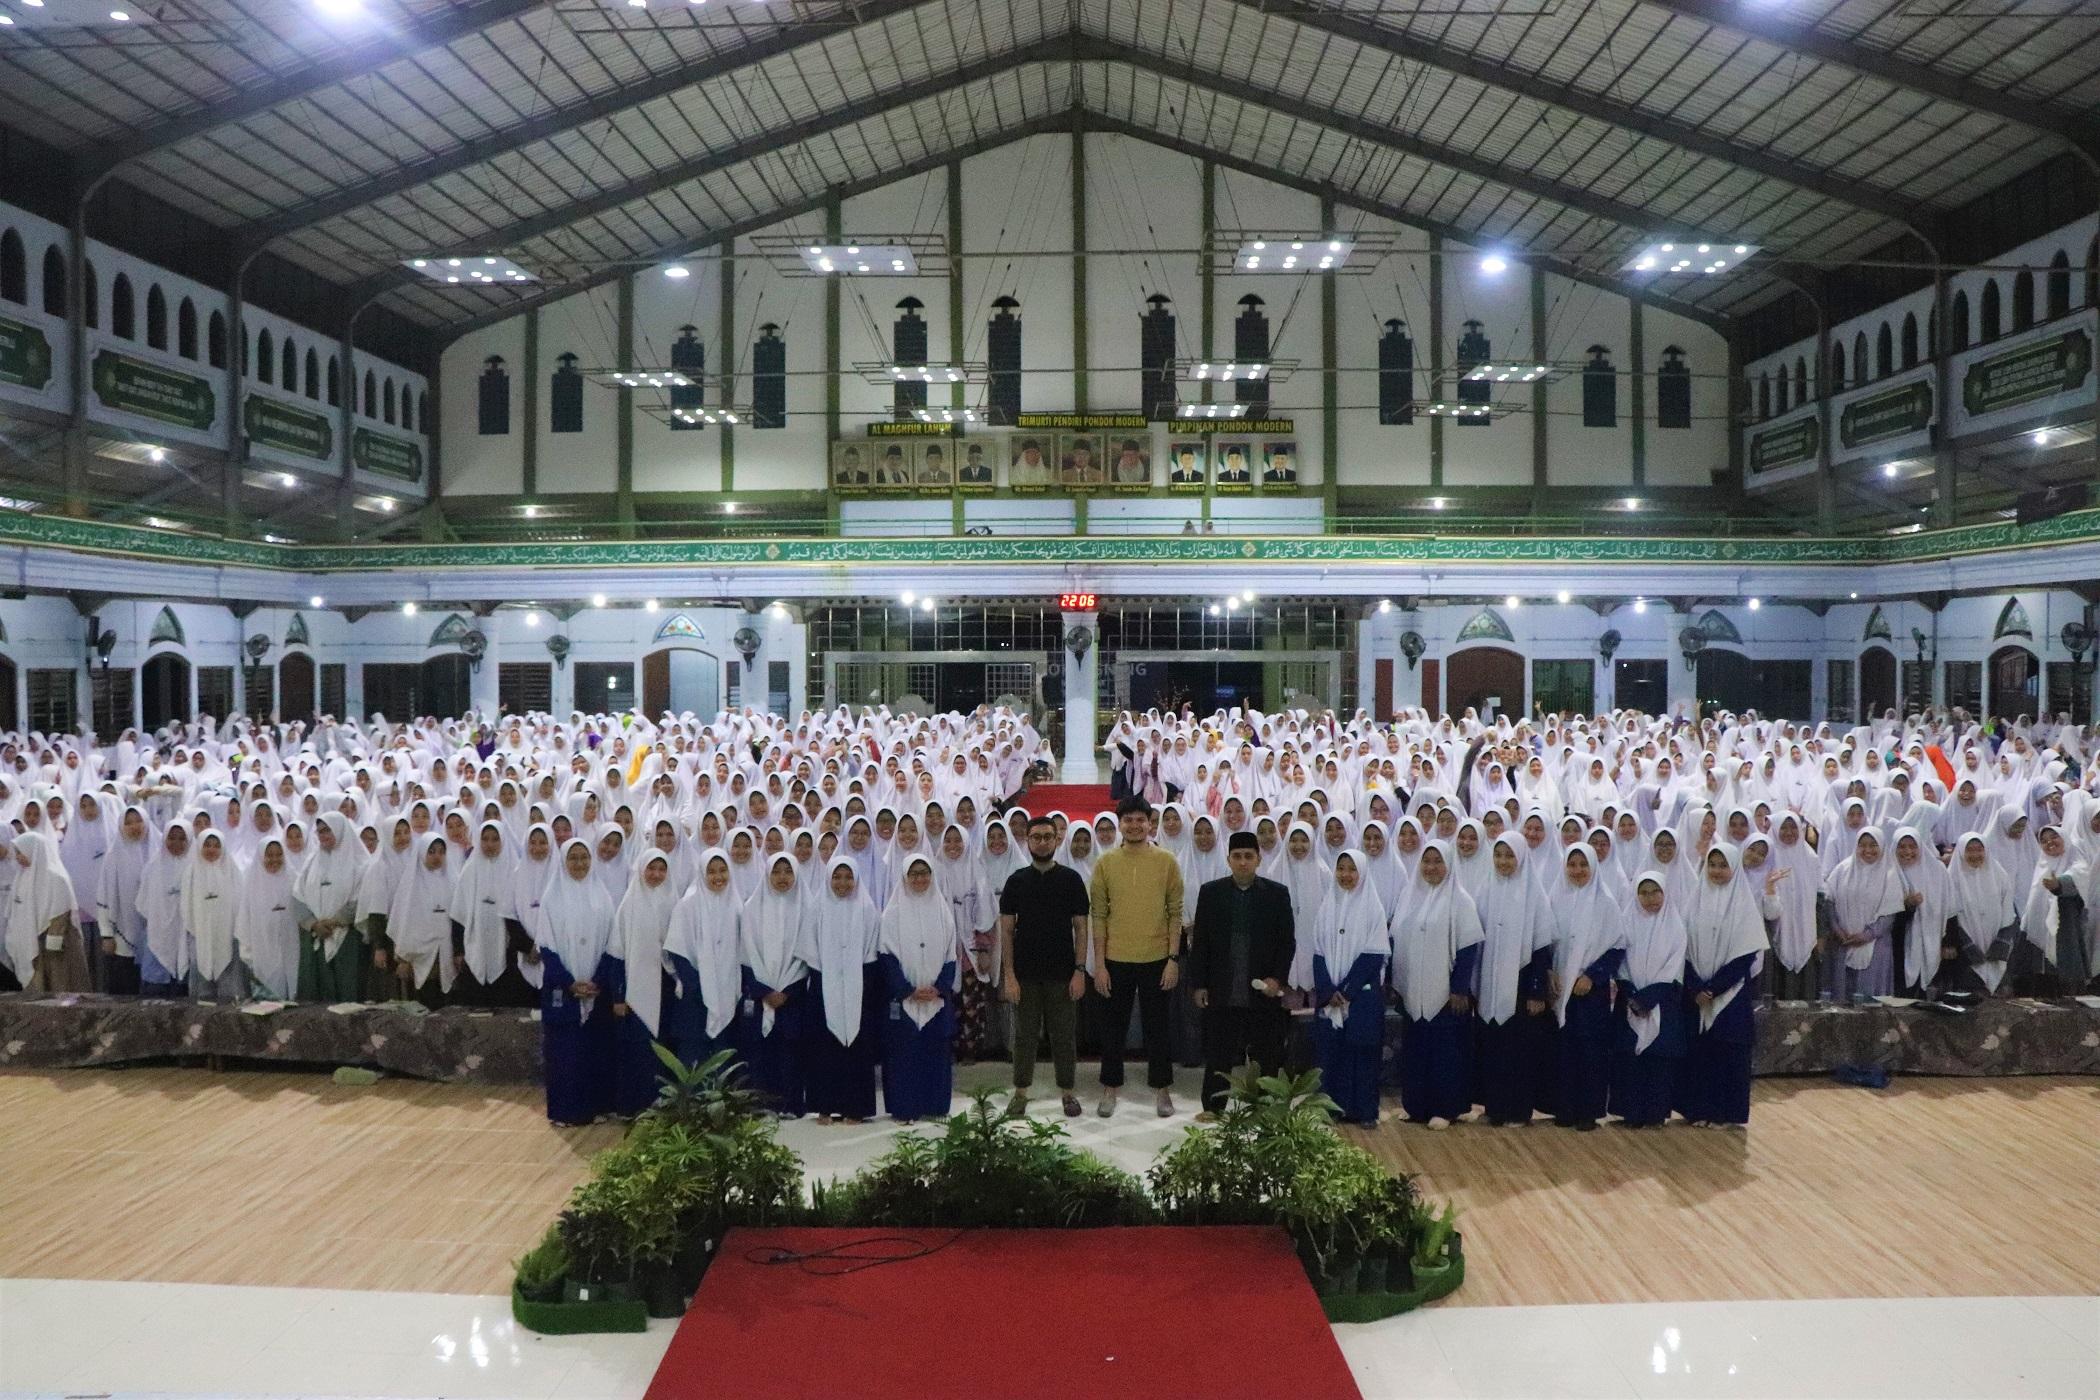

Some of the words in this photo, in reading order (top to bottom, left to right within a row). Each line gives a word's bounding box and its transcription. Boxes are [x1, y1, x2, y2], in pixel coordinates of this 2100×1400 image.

[1018, 416, 1051, 426] TRIMURTI
[1053, 416, 1082, 426] PENDIRI
[1084, 416, 1114, 426] PONDOK
[1115, 416, 1146, 426] MODERN
[872, 424, 881, 434] AL
[883, 424, 921, 434] MAGHFUR
[1169, 421, 1215, 432] PIMPINAN
[1217, 421, 1253, 432] PONDOK
[1256, 421, 1292, 432] MODERN
